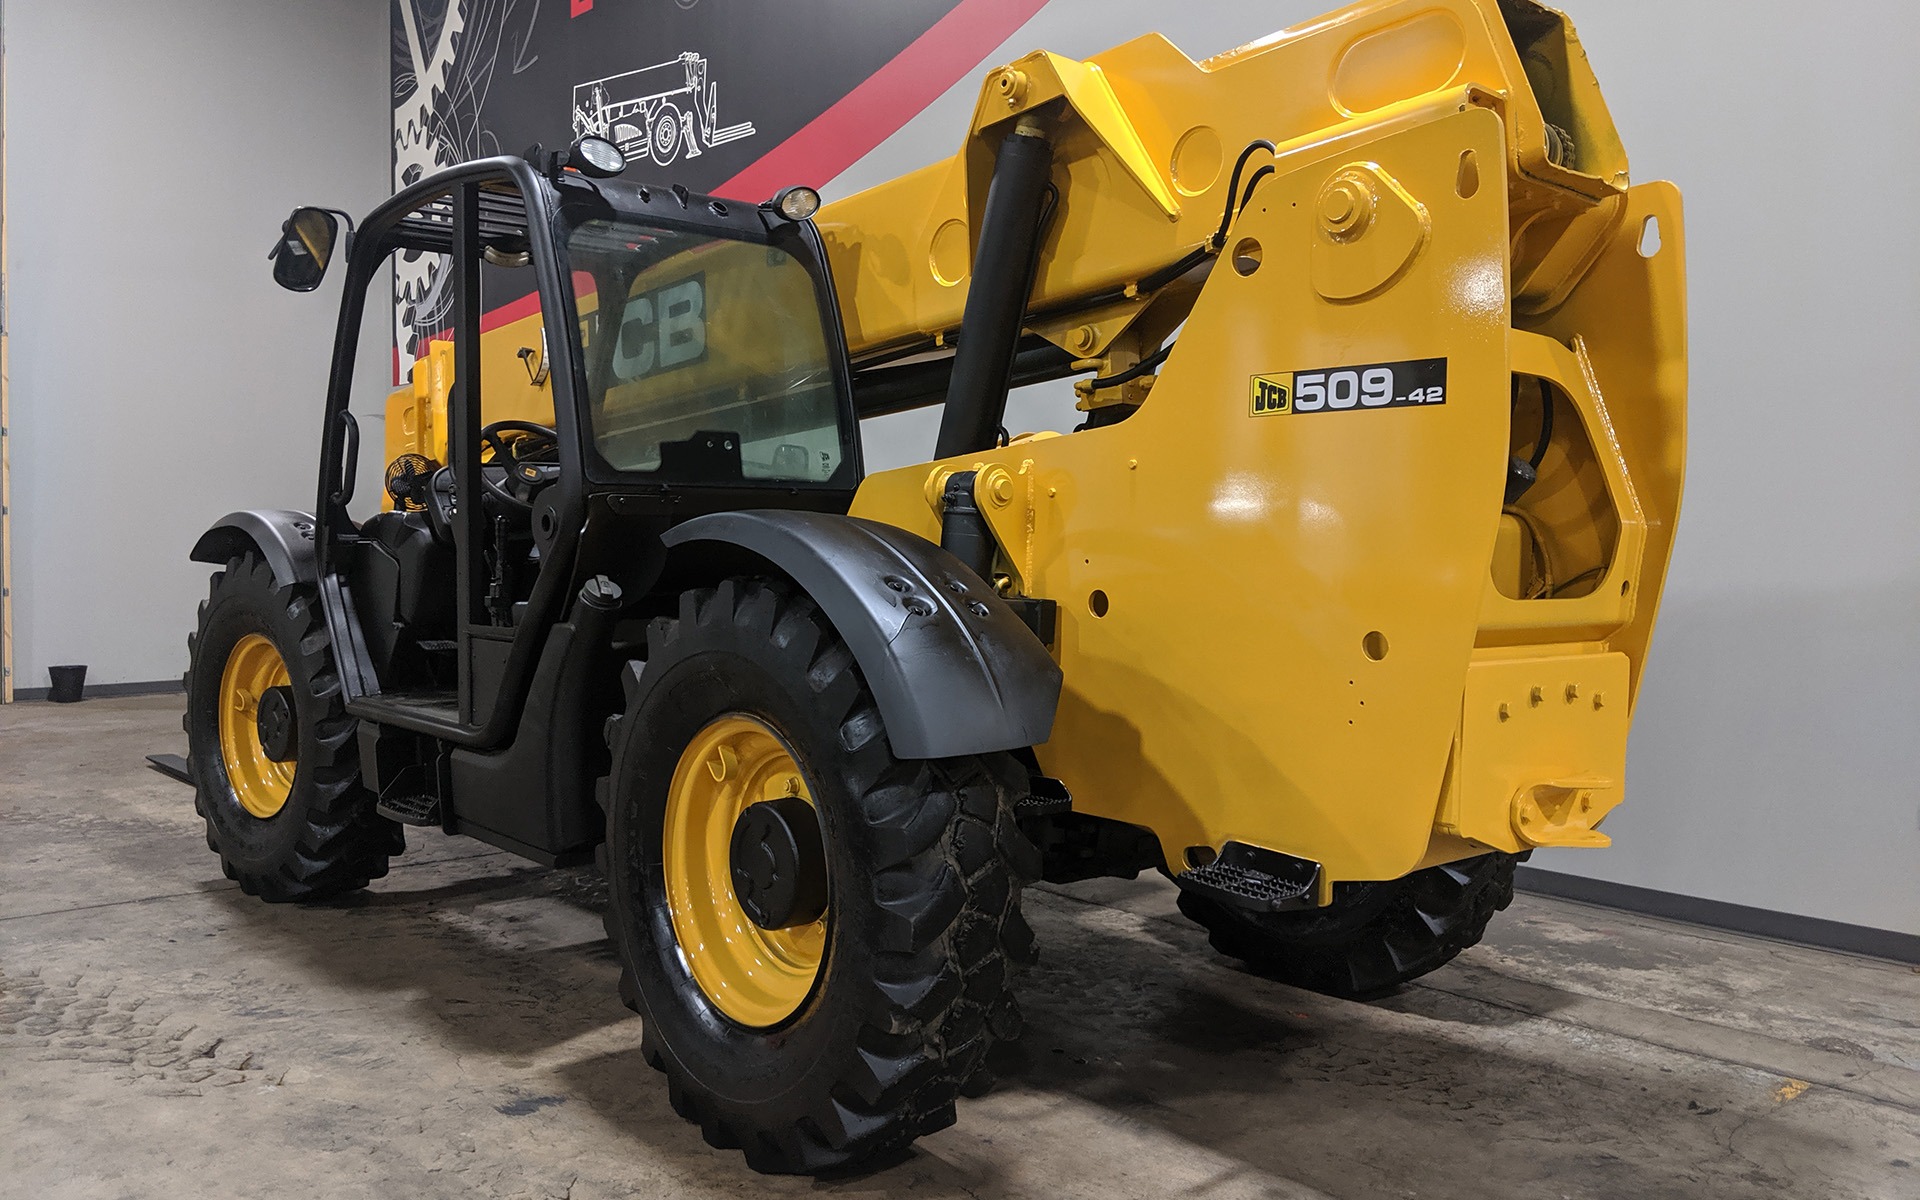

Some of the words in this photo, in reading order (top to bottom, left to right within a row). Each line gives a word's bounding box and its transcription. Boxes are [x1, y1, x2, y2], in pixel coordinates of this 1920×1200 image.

[597, 281, 706, 379] CB
[1255, 381, 1287, 411] JCB
[1295, 367, 1443, 411] 509-42
